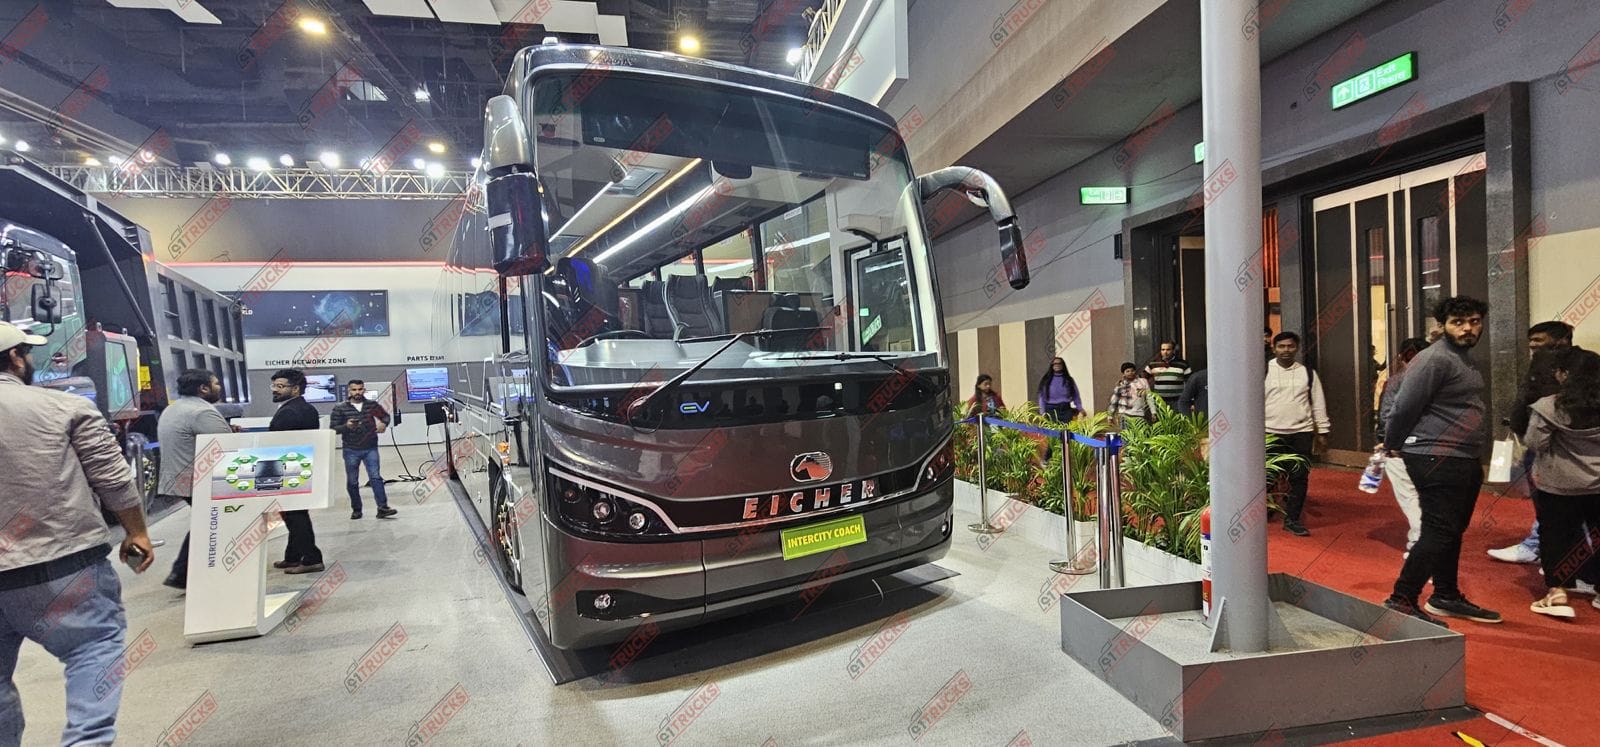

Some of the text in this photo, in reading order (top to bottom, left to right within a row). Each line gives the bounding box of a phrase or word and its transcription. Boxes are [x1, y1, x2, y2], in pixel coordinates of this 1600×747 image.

[680, 401, 710, 414] EV
[743, 480, 874, 519] EICHER
[208, 506, 218, 567] INTERCITY COACH
[788, 524, 861, 548] INTERCITY COACH
